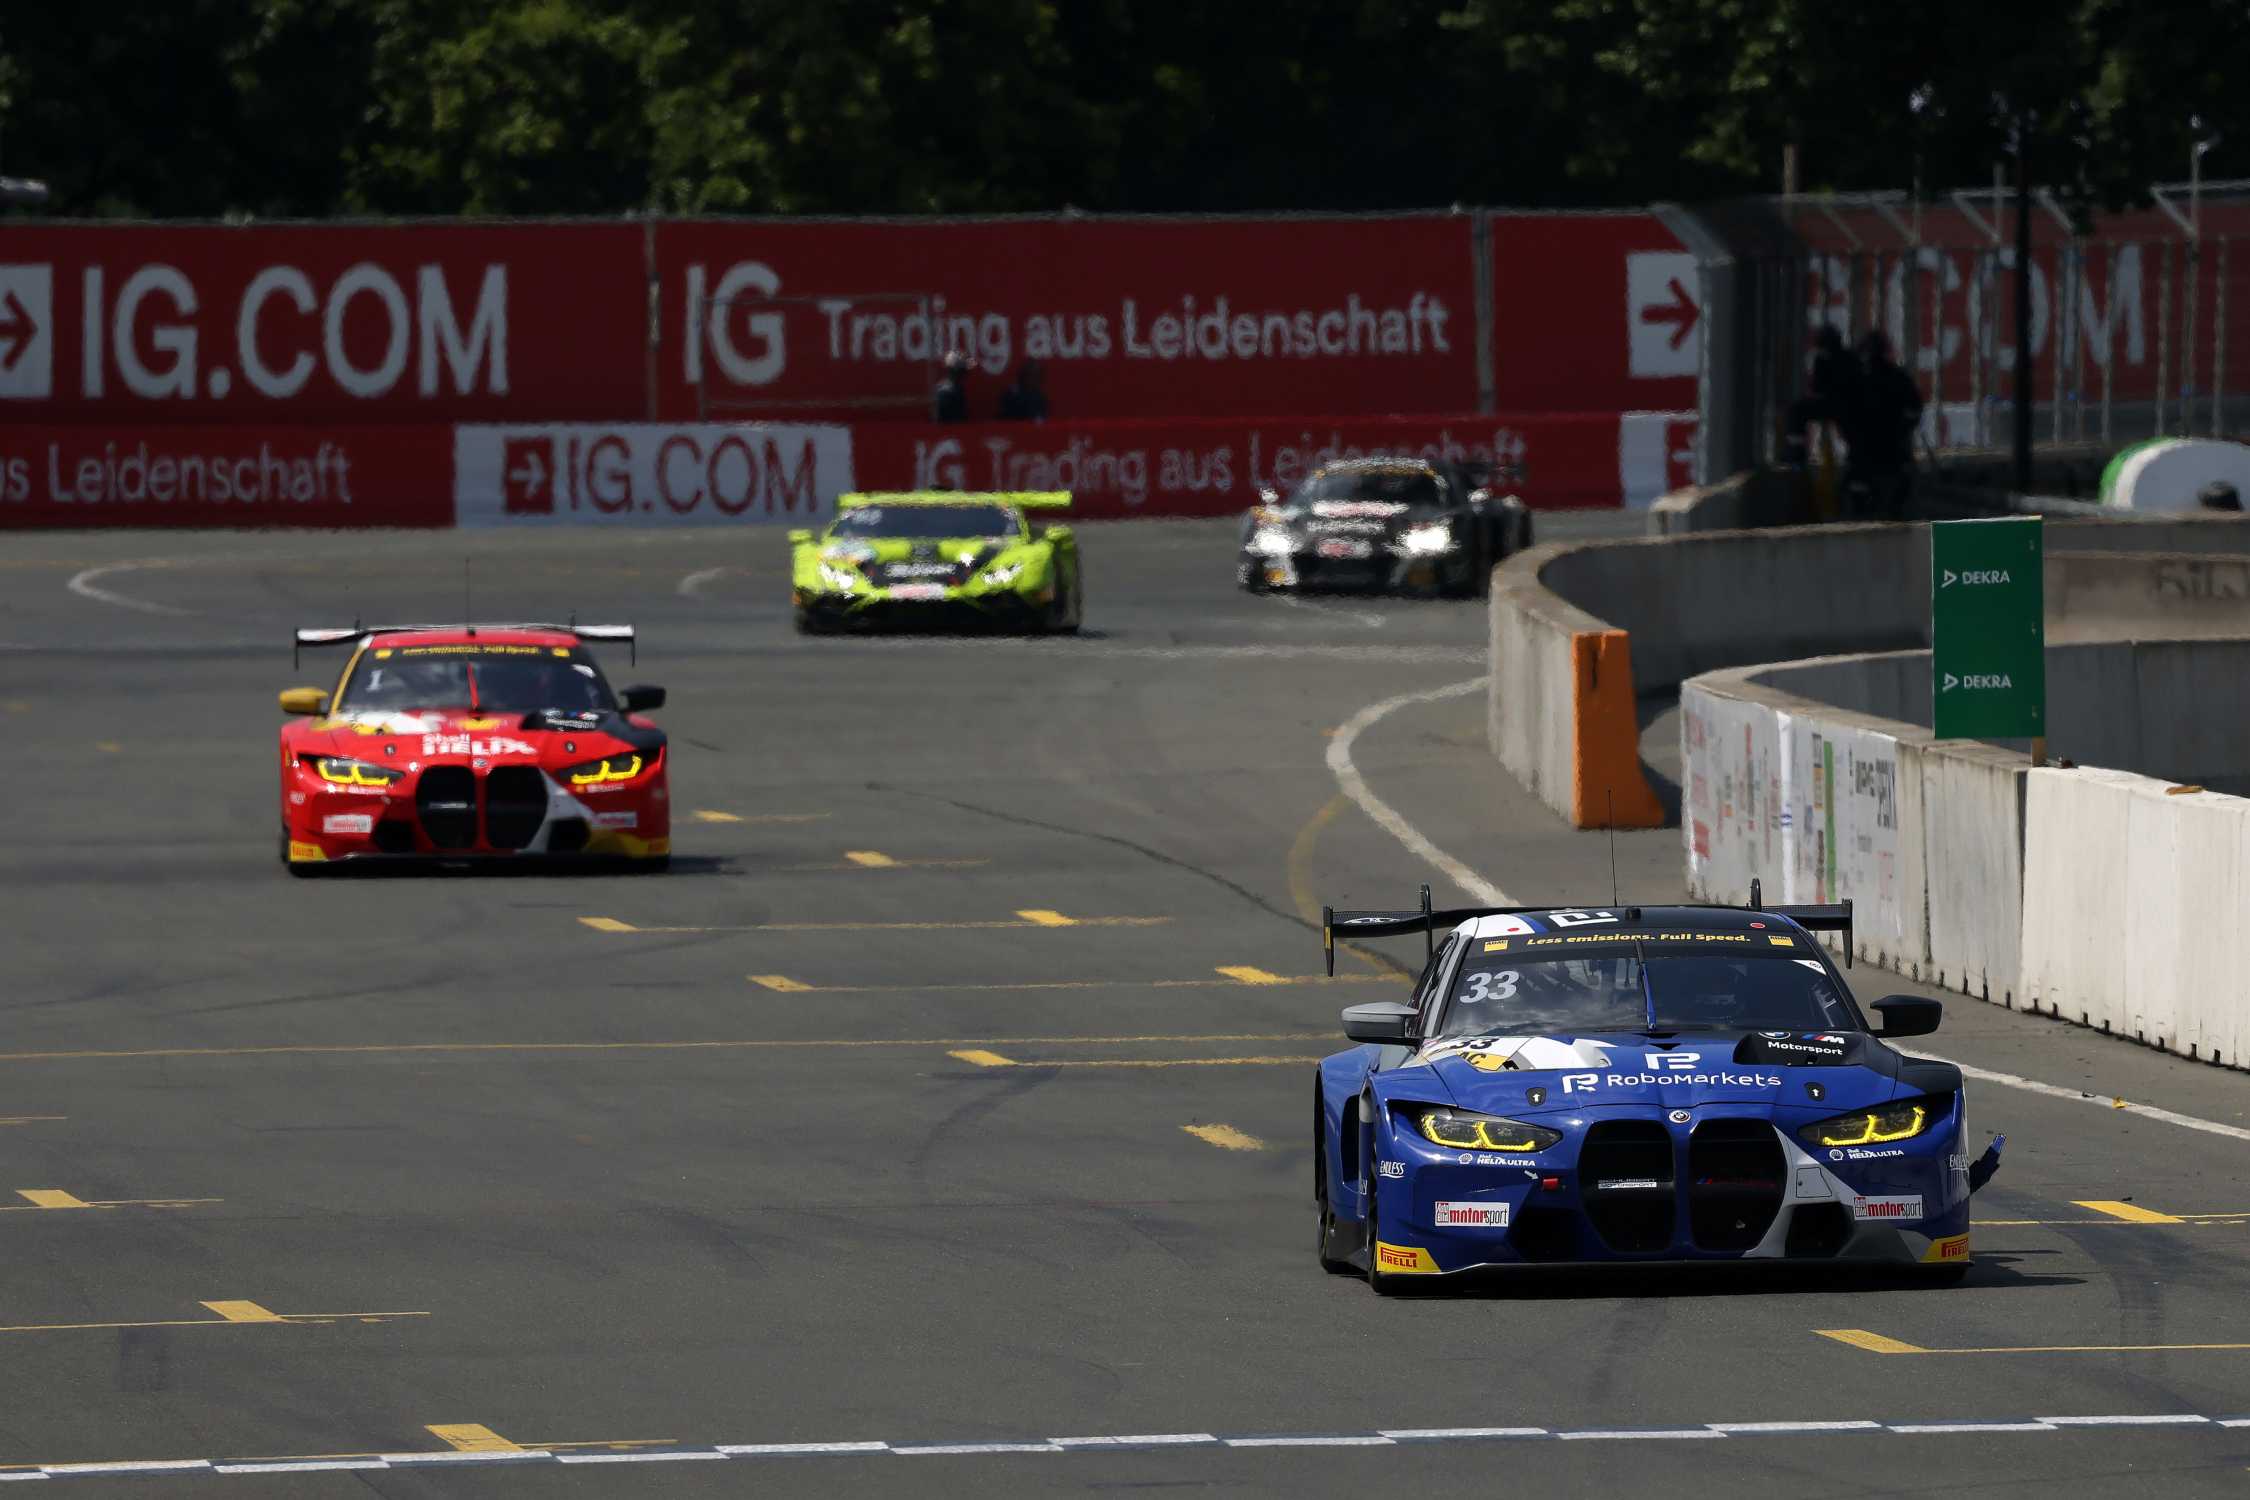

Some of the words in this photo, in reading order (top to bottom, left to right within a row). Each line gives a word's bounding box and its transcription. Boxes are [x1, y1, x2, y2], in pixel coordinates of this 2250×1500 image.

[82, 263, 509, 399] IG.COM
[684, 261, 787, 385] IG
[820, 294, 1011, 374] Trading
[1025, 311, 1111, 359] aus
[1122, 291, 1450, 359] Leidenschaft
[49, 440, 352, 504] Leidenschaft
[567, 434, 817, 515] IG.COM
[914, 440, 967, 491] IG
[984, 435, 1148, 506] Trading
[1159, 447, 1234, 491] aus
[1962, 570, 2011, 585] DEKRA
[1963, 674, 2013, 689] DEKRA
[1566, 934, 1656, 942] emissions.
[1695, 934, 1751, 942] Speed.
[1459, 970, 1520, 1004] 33
[1767, 1041, 1844, 1056] Motorsport
[1607, 1072, 1782, 1087] RoboMarkets
[1506, 1159, 1536, 1167] ULTRA
[1449, 1207, 1508, 1226] motorsport
[1868, 1202, 1921, 1219] motorsport
[1381, 1246, 1417, 1268] PIRELLI
